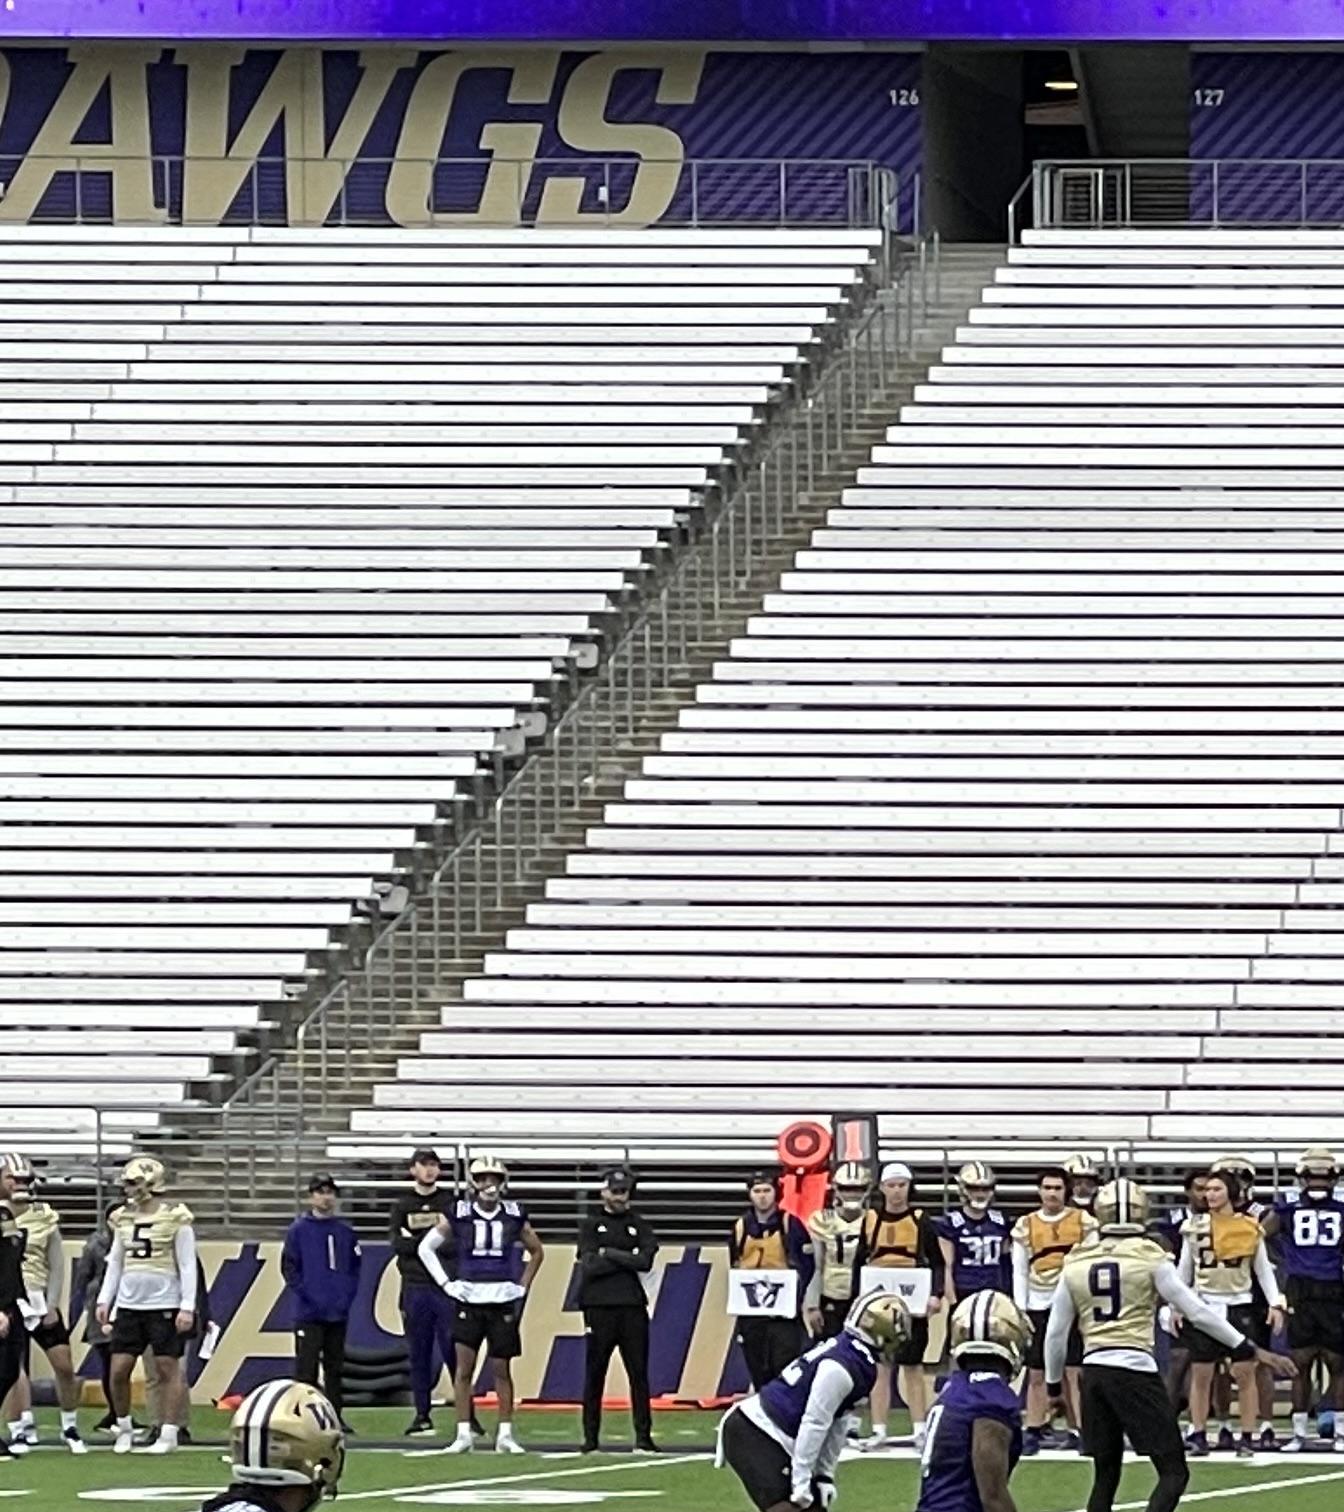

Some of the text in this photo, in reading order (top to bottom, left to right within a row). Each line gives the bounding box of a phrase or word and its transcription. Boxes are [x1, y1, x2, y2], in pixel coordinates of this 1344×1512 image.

[889, 88, 919, 106] 126
[1194, 88, 1224, 106] 127
[0, 50, 712, 229] AWGS
[843, 1121, 863, 1161] 1
[124, 1223, 151, 1259] 5
[472, 1220, 504, 1257] 11
[1293, 1209, 1342, 1247] 83
[960, 1236, 1003, 1266] 30
[1089, 1261, 1121, 1322] 9
